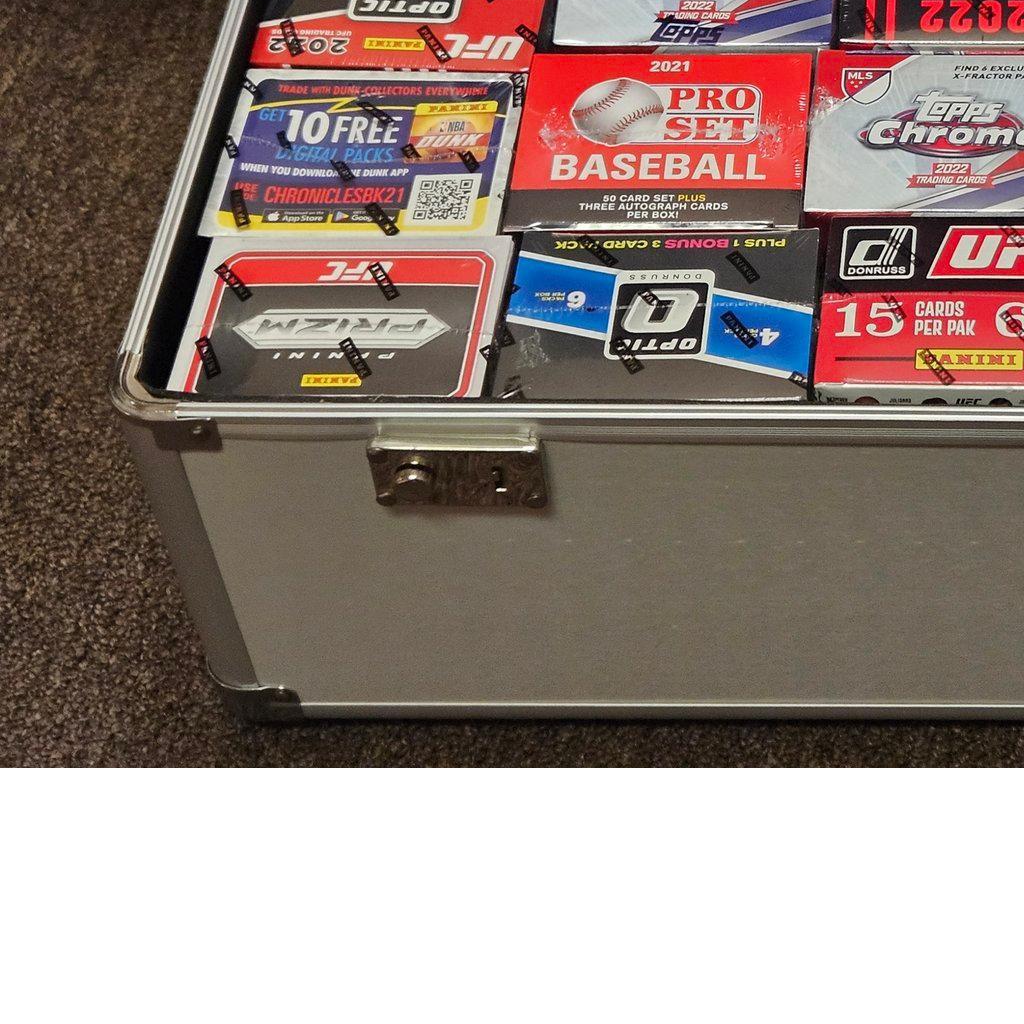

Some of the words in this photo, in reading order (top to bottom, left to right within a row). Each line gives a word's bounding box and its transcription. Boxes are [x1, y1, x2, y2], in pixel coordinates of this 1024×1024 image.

[359, 0, 450, 14] OPTIC
[681, 0, 714, 10] 2022
[701, 12, 731, 20] CARDS
[368, 40, 422, 48] PANINI
[444, 34, 525, 60] UFC
[649, 61, 690, 72] 2021
[848, 72, 873, 80] MLS
[279, 84, 308, 94] TRADE
[425, 86, 489, 96] EVERYWHERE
[668, 88, 756, 110] PRO
[428, 104, 488, 112] PANINI
[259, 109, 286, 122] GET
[287, 109, 329, 144] 10
[331, 116, 403, 144] FREE
[664, 117, 754, 140] SET
[417, 134, 484, 147] DUNK
[344, 147, 394, 161] PACKS
[240, 163, 269, 172] WHEN
[271, 166, 291, 175] YOU
[363, 169, 388, 177] DUNK
[550, 154, 766, 180] BASEBALL
[935, 164, 969, 174] 2022
[916, 175, 954, 184] TRADING
[956, 176, 988, 184] CARDS
[264, 186, 405, 204] CHRONICLESBK21
[603, 194, 616, 202] 50
[619, 194, 650, 202] CARD
[653, 194, 674, 202] SET
[678, 194, 706, 202] PLUS
[618, 203, 688, 211] AUTOGRAPH
[690, 202, 728, 210] CARDS
[652, 211, 679, 219] BOX!
[602, 240, 649, 249] CARD
[665, 239, 729, 248] BONUS
[744, 239, 786, 247] PLUS
[847, 265, 906, 275] DONRUSS
[566, 291, 586, 308] 6
[915, 301, 964, 317] CARDS
[834, 302, 905, 337] 15
[254, 318, 429, 336] PRIZM
[914, 320, 943, 336] PER
[947, 320, 976, 336] PAK
[759, 328, 780, 346] 4
